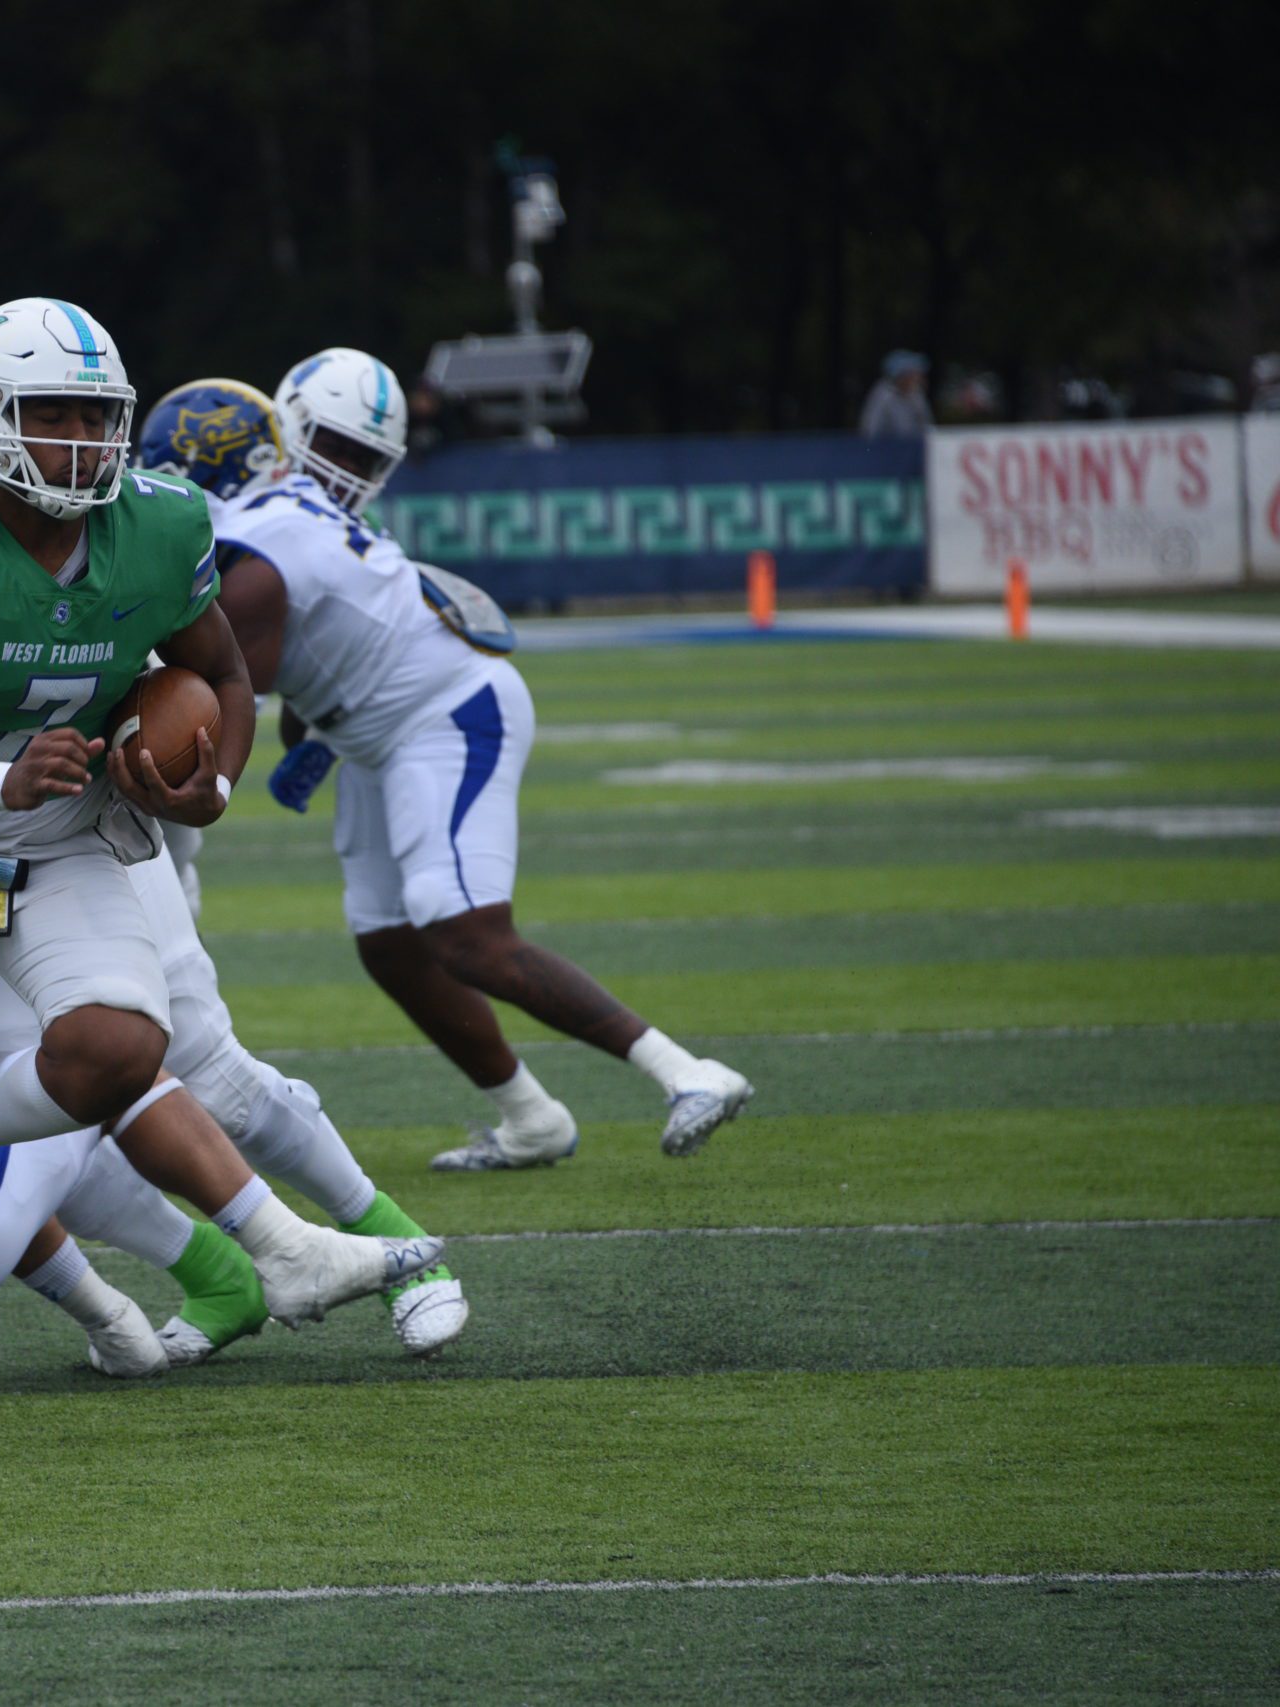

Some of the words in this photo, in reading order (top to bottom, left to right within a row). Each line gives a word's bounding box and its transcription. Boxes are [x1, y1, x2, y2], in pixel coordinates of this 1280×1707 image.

[130, 472, 193, 499] 7
[959, 430, 1209, 514] SONNY'S
[1, 641, 44, 663] WEST
[49, 640, 115, 665] FLORIDA
